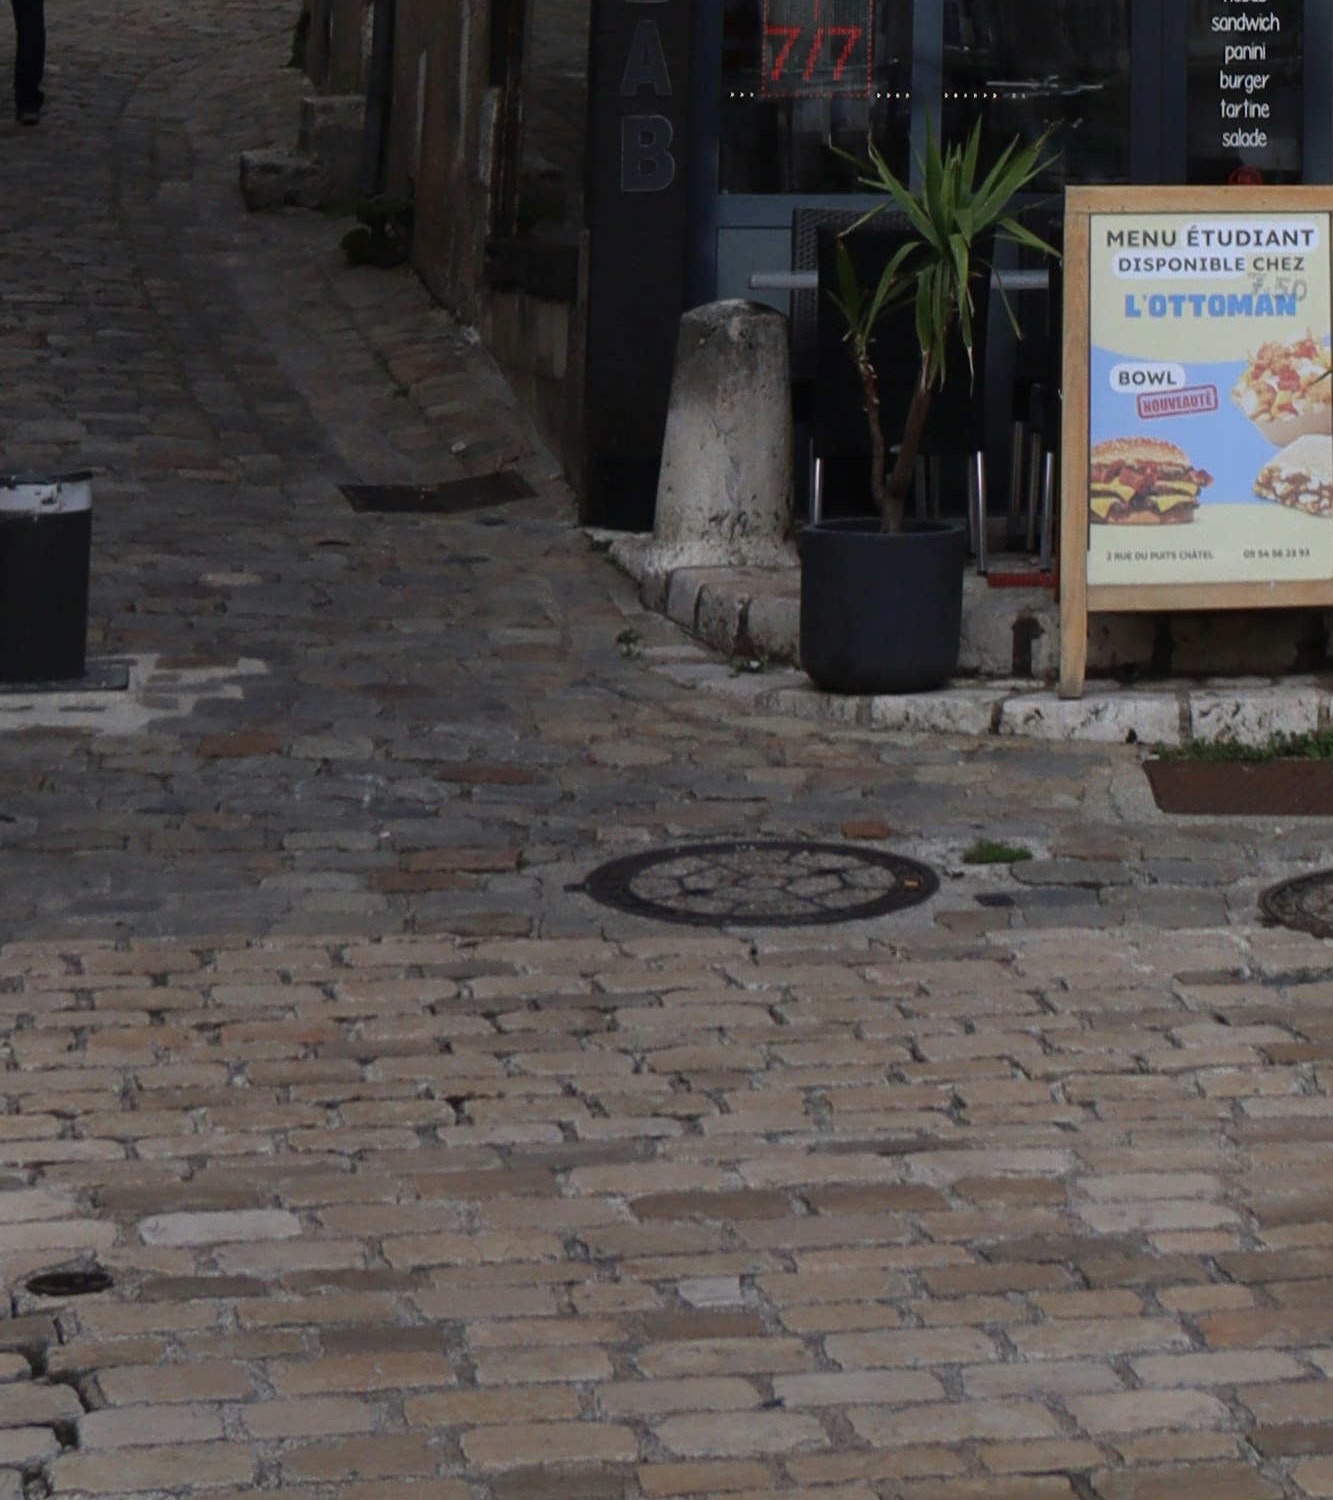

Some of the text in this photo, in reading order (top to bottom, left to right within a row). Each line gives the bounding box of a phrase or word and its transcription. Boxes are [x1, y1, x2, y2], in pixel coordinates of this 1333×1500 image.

[1211, 12, 1280, 32] sandwich
[766, 26, 861, 81] 7/7
[1224, 42, 1266, 64] panini
[1220, 70, 1270, 94] burger
[1220, 98, 1270, 118] tartine
[1222, 128, 1267, 147] salade
[1106, 225, 1314, 247] MENU ÉTUDIANT
[1119, 257, 1304, 272] DISPONIBLE CHEZ
[1124, 293, 1296, 318] L'OTTOMAN
[1119, 371, 1176, 385] BOWL
[1143, 392, 1213, 413] NOUVEAUTÉ
[1114, 551, 1132, 560] RUE
[1135, 551, 1148, 560] DU
